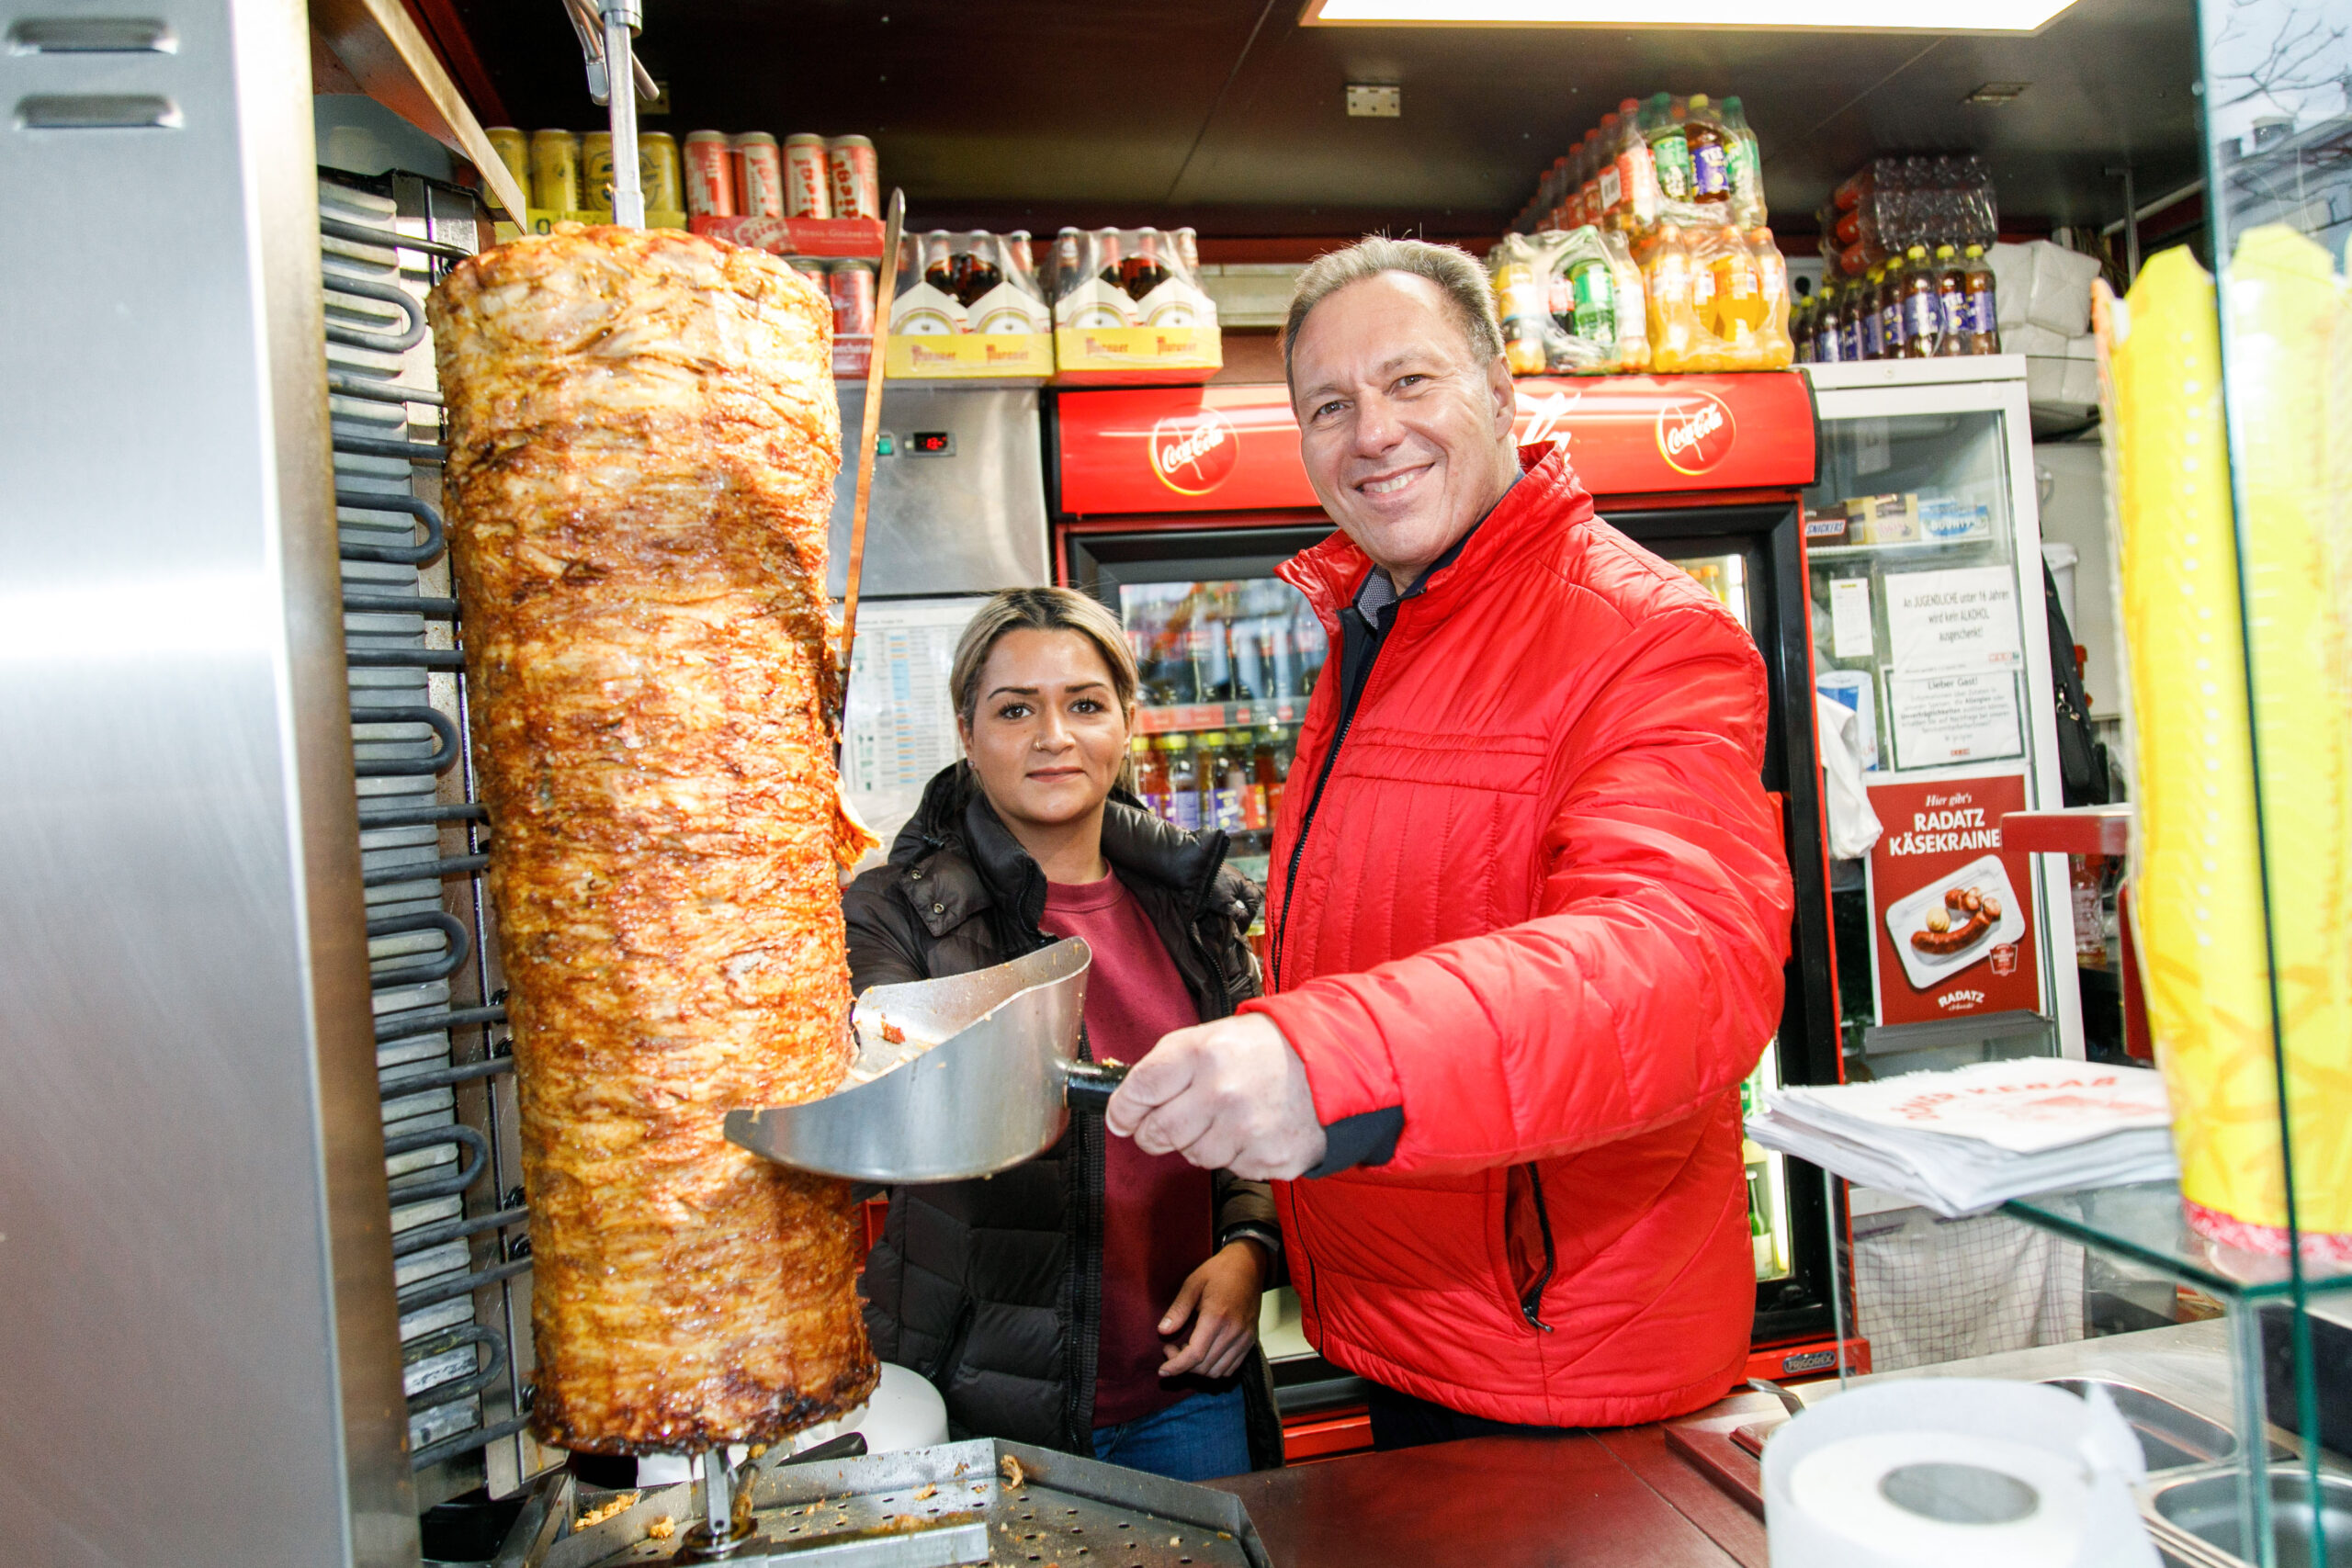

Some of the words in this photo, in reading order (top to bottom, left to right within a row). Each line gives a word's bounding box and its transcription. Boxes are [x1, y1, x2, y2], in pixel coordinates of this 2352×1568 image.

[1668, 402, 1723, 455] Coca-Cola
[1162, 420, 1225, 473] Coca-Cola
[1806, 521, 1846, 535] SNICKERS
[1931, 518, 1973, 531] BOUNTY
[1904, 597, 1912, 607] An
[1914, 592, 1959, 607] JUGENDLICHE
[1960, 592, 1976, 604] unter
[1989, 589, 2009, 602] Jahren
[1928, 611, 1943, 623] wird
[1945, 610, 1959, 623] kein
[1961, 608, 1990, 621] ALKOHOL
[1939, 626, 1984, 643] ausgeschenkt!
[1928, 680, 1954, 690] Lieber
[1957, 677, 1978, 687] Gast!
[1926, 795, 1948, 807] Hier
[1949, 792, 1973, 807] gibt's
[1914, 807, 1985, 832] RADATZ
[1889, 828, 2001, 856] KÄSEKRAINE
[1938, 989, 1985, 1008] RADATZ
